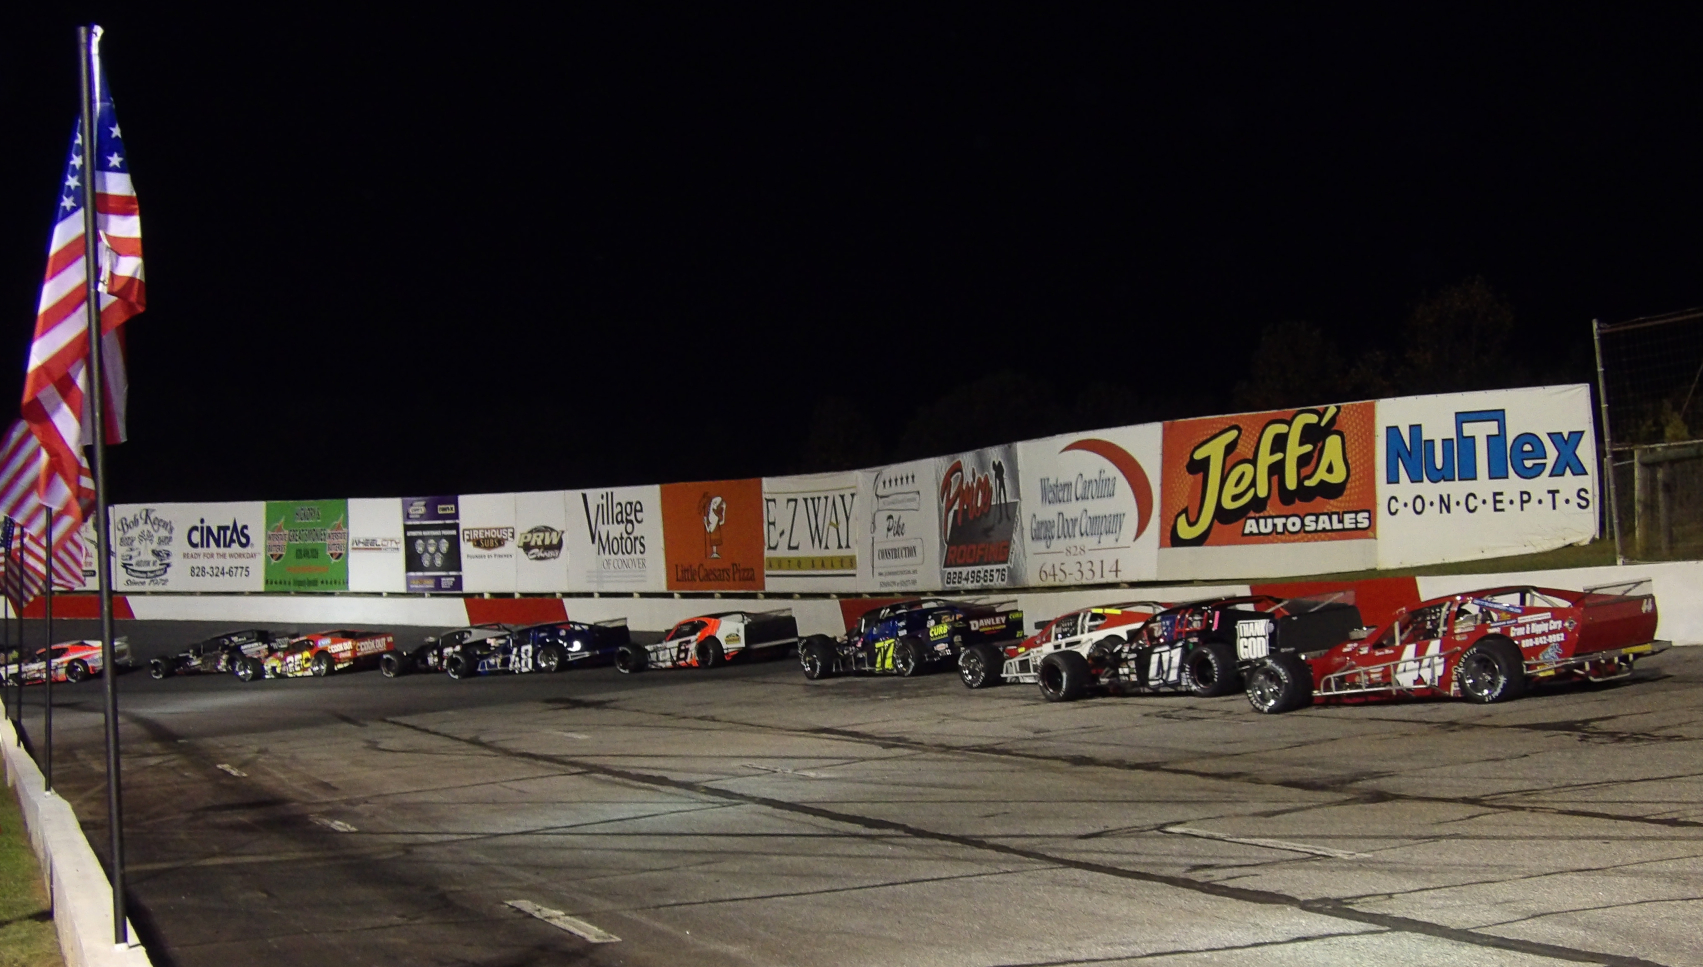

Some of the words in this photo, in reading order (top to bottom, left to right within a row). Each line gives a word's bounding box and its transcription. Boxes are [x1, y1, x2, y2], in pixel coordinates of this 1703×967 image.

[1039, 477, 1072, 504] Western
[1074, 469, 1117, 501] Carolina
[117, 513, 140, 534] Bob
[581, 491, 644, 545] Village
[764, 497, 800, 550] E-Z
[802, 493, 856, 549] WAY
[1030, 513, 1056, 548] Garage
[1057, 511, 1078, 539] Door
[1079, 509, 1126, 544] Company
[1243, 516, 1302, 534] AUTO
[1304, 511, 1370, 532] SALES
[463, 528, 514, 543] FIREHOUSE
[518, 532, 562, 546] PRW
[598, 530, 646, 555] Motors
[946, 541, 1010, 565] ROOFING
[1065, 545, 1086, 556] 828
[190, 566, 250, 577] 828-324-6775
[603, 559, 611, 570] OF
[613, 558, 646, 569] CONOVER
[675, 564, 697, 582] Little
[698, 564, 730, 581] Caesars
[731, 563, 756, 581] Pizza
[1039, 559, 1121, 582] 645-3314
[929, 623, 949, 637] CURB
[970, 616, 1006, 631] DAWLEY
[1240, 621, 1267, 637] THANK
[1240, 637, 1267, 660] GOD
